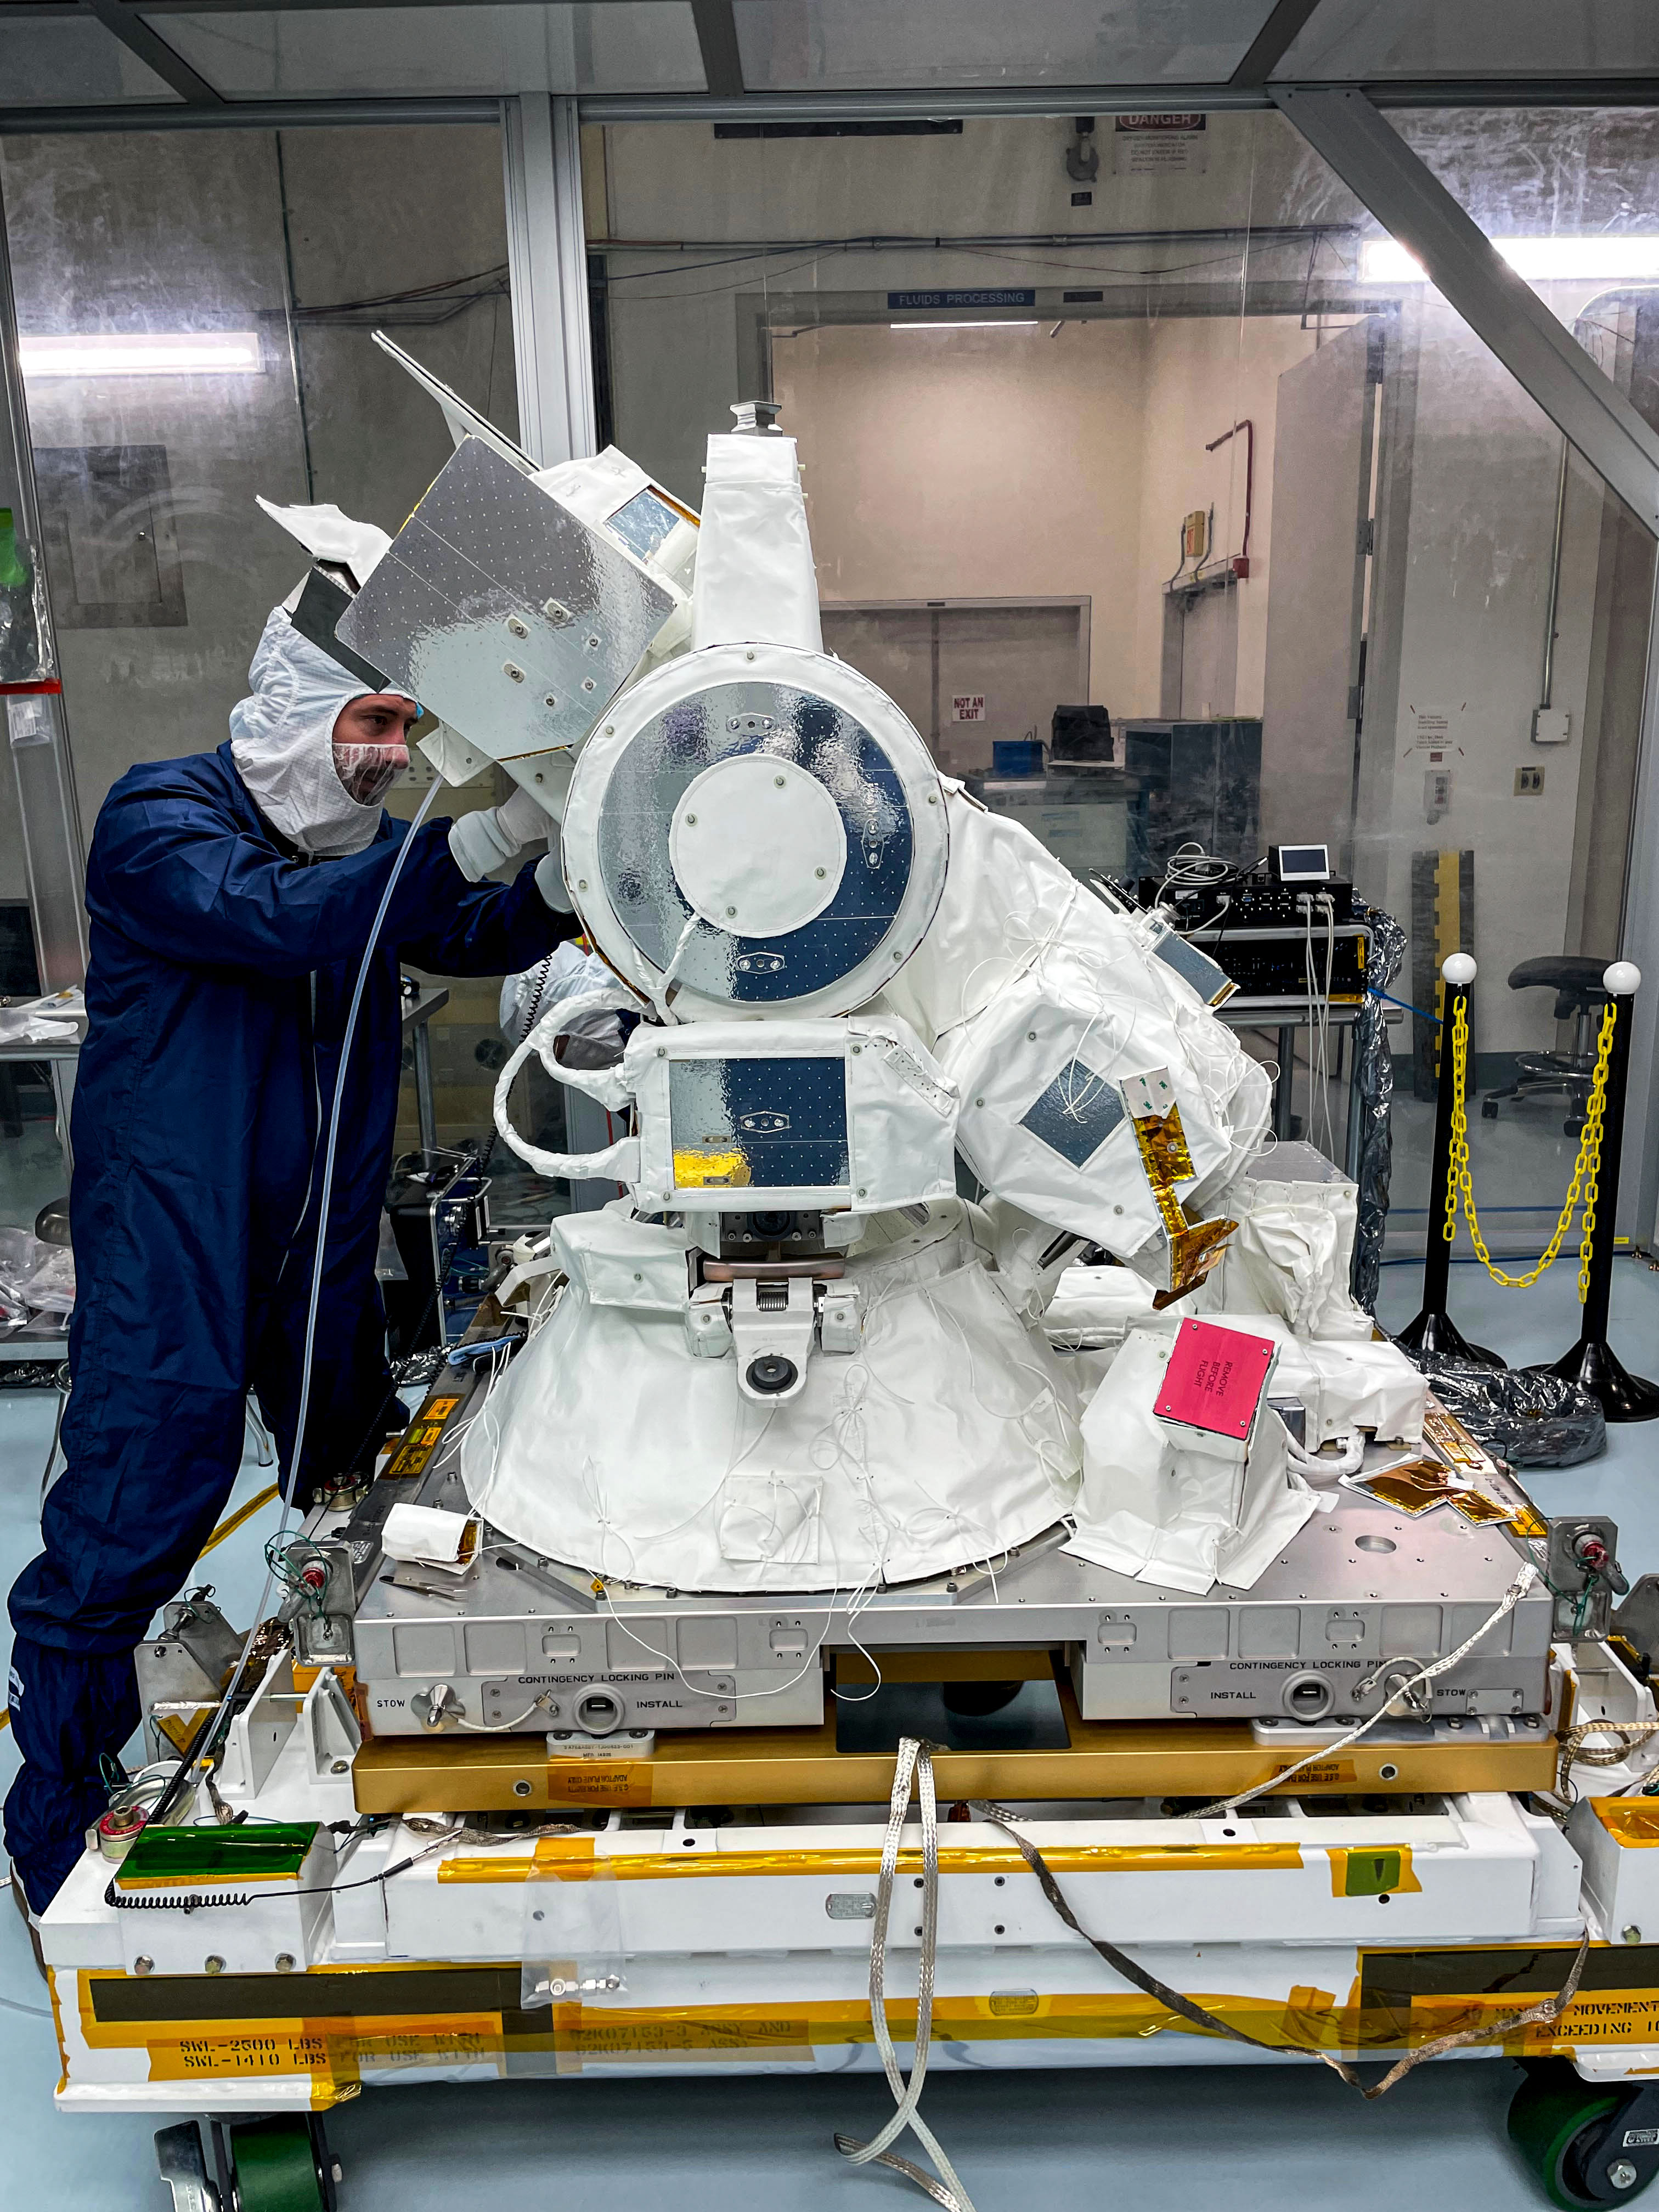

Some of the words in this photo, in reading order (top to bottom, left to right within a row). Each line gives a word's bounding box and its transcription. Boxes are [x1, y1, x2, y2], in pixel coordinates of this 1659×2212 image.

[1129, 114, 1192, 125] DANGER
[899, 295, 941, 306] FLUIDS
[947, 293, 1025, 304] PROCESSING
[954, 698, 970, 709] NOT
[973, 697, 984, 708] AN
[960, 709, 979, 720] EXIT
[1194, 1360, 1209, 1387] FLIGHT
[1204, 1361, 1221, 1393] BEFORE
[1216, 1361, 1233, 1397] REMOVE
[1229, 1662, 1307, 1671] CONTINGENCY
[1313, 1661, 1362, 1670] LOCKING
[1367, 1661, 1387, 1669] PIN
[518, 1674, 595, 1684] CONTINGENCY
[601, 1673, 650, 1683] LOCKING
[655, 1672, 675, 1681] PIN
[1210, 1691, 1257, 1700] INSTALL
[1436, 1688, 1466, 1697] STOW
[376, 1699, 406, 1708] STOW
[636, 1700, 683, 1709] INSTALL
[1573, 2000, 1659, 2017] MOVEMENT
[759, 2021, 791, 2033] AND
[1536, 2021, 1632, 2038] EXCEEDING
[180, 2038, 276, 2054] SWL-2500
[288, 2037, 323, 2051] LBS
[184, 2053, 281, 2069] SWL-1410
[294, 2051, 328, 2066] LBS
[340, 2051, 376, 2063] FOR
[390, 2049, 424, 2061] USE
